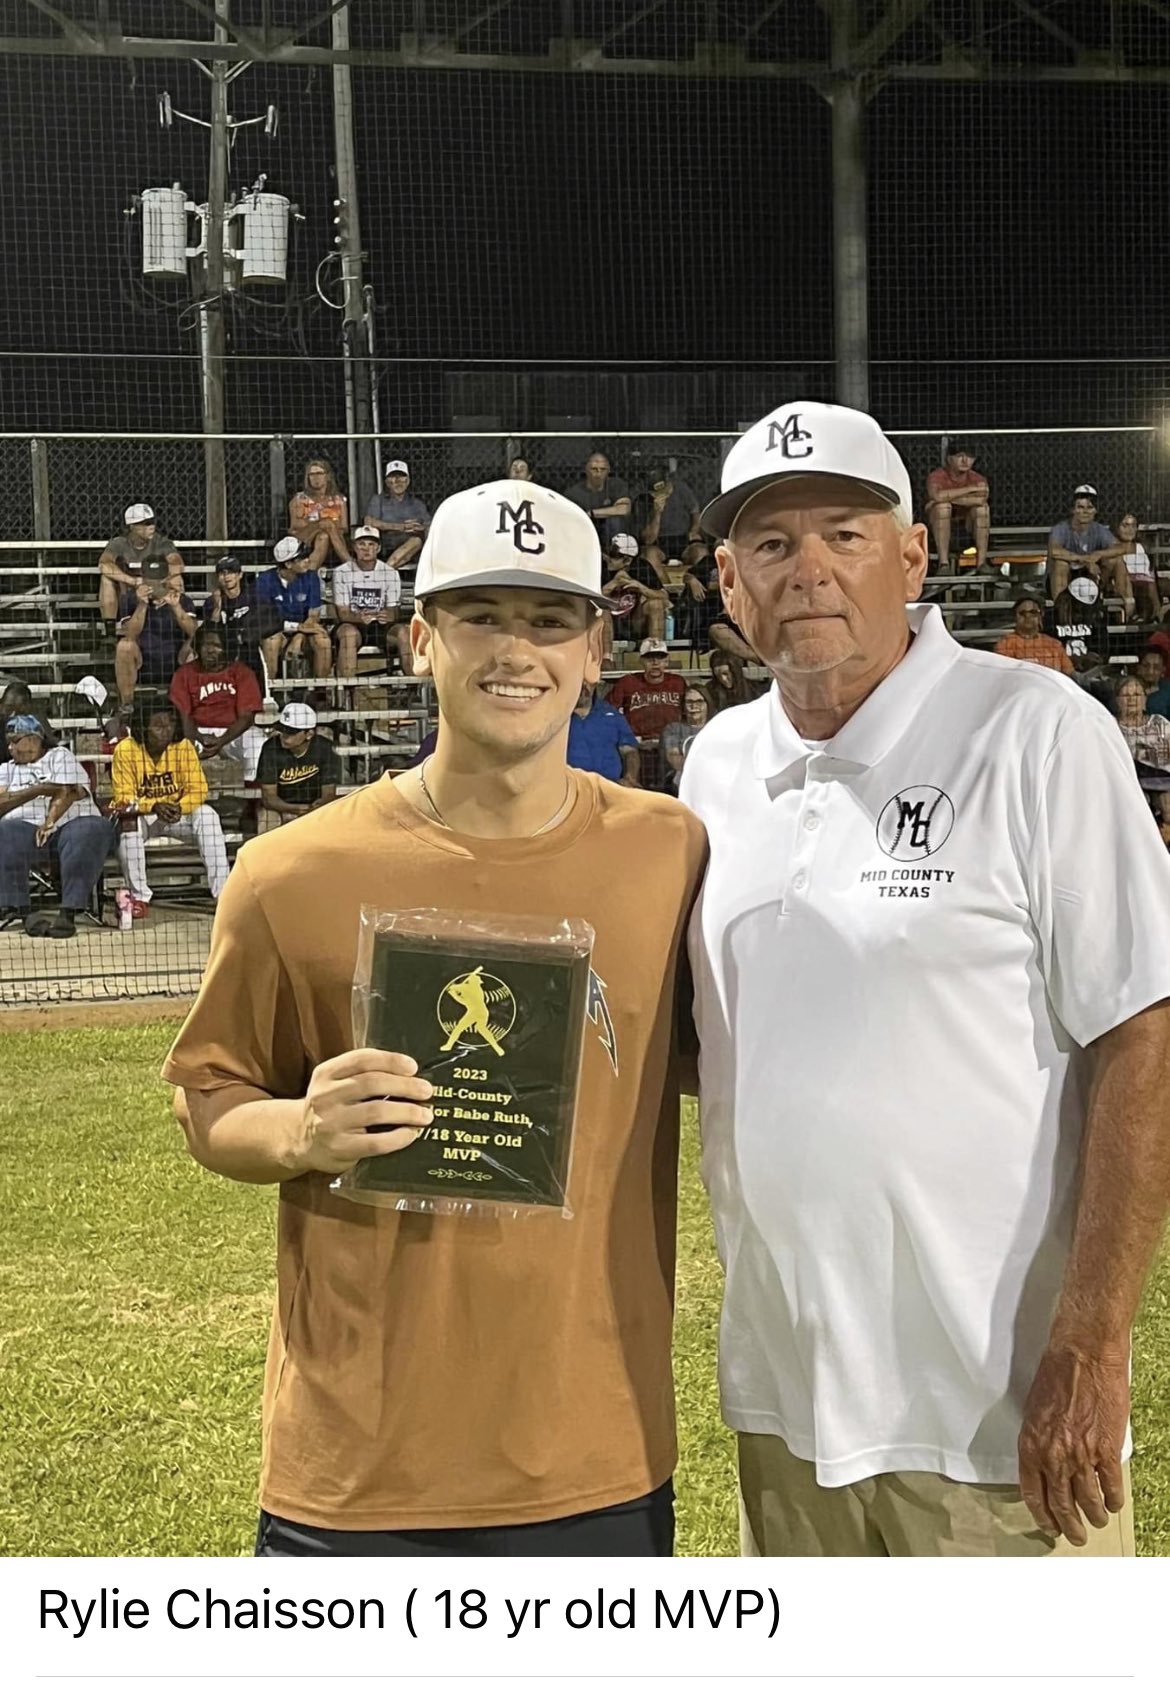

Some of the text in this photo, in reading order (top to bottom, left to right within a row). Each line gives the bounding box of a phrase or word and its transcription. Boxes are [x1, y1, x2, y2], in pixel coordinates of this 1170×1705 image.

[765, 413, 813, 459] MC
[496, 500, 545, 555] MC
[897, 801, 930, 847] MC
[860, 869, 955, 883] MID COUNTY
[878, 886, 930, 898] TEXAS
[453, 1068, 488, 1081] 2023
[453, 1107, 490, 1121] Babe
[454, 1130, 490, 1144] Year
[494, 1133, 522, 1147] Old
[443, 1147, 481, 1161] MVP
